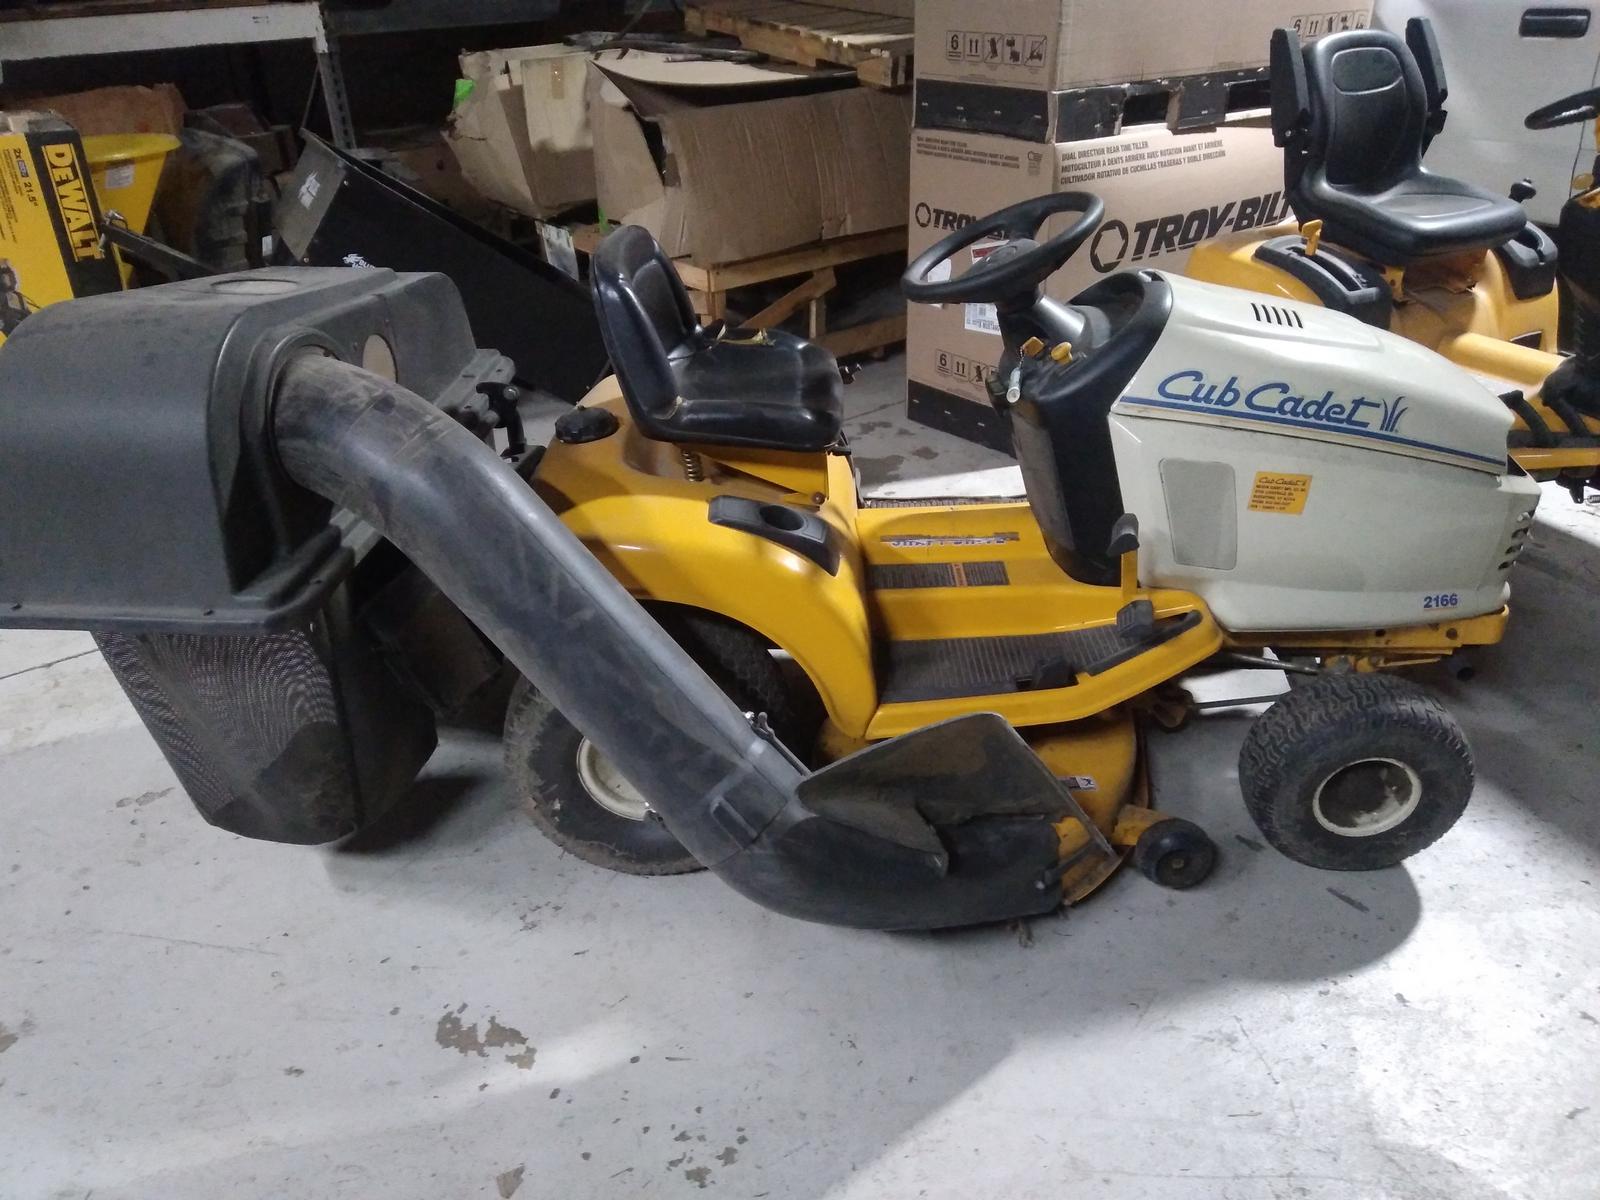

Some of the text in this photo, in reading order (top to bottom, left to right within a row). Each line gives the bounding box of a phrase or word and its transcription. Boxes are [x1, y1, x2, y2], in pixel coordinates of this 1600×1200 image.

[1061, 152, 1077, 162] DUAL
[1106, 145, 1120, 155] REAR
[1132, 141, 1149, 151] TILLER
[1061, 160, 1101, 174] MOTOCULTEUR
[1107, 155, 1124, 167] DENTS
[1060, 171, 1096, 185] CULTIVADOR
[44, 144, 103, 260] DEWALT
[1157, 370, 1381, 428] Cub Cadet
[1423, 593, 1458, 609] 2166
